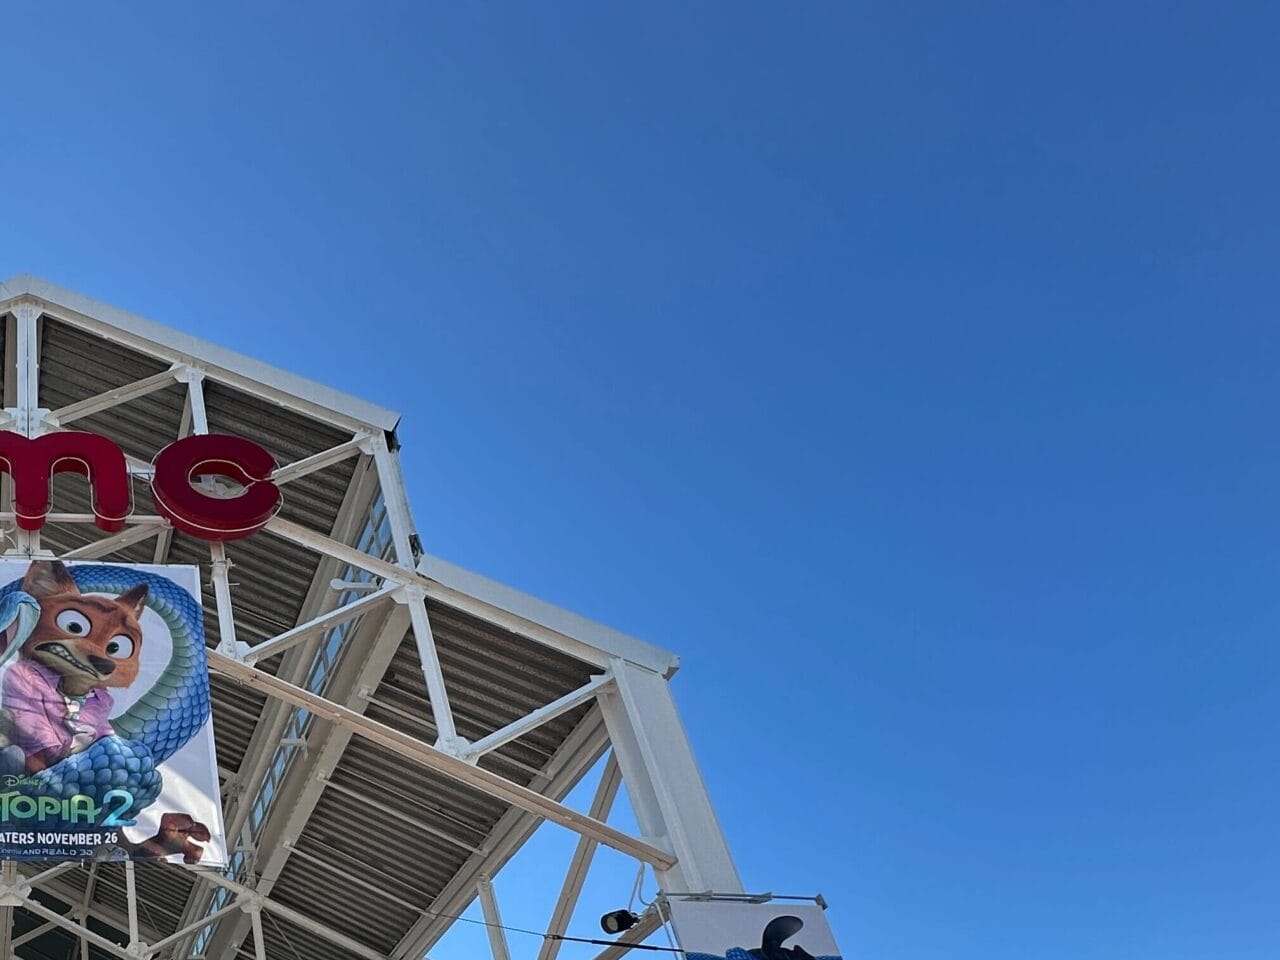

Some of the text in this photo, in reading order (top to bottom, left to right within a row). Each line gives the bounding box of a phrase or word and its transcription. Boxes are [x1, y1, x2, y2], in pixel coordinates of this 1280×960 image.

[2, 774, 48, 790] Disney
[100, 789, 138, 827] 2
[37, 832, 102, 845] NOVEMBER
[104, 832, 118, 844] 26
[22, 848, 41, 856] AND
